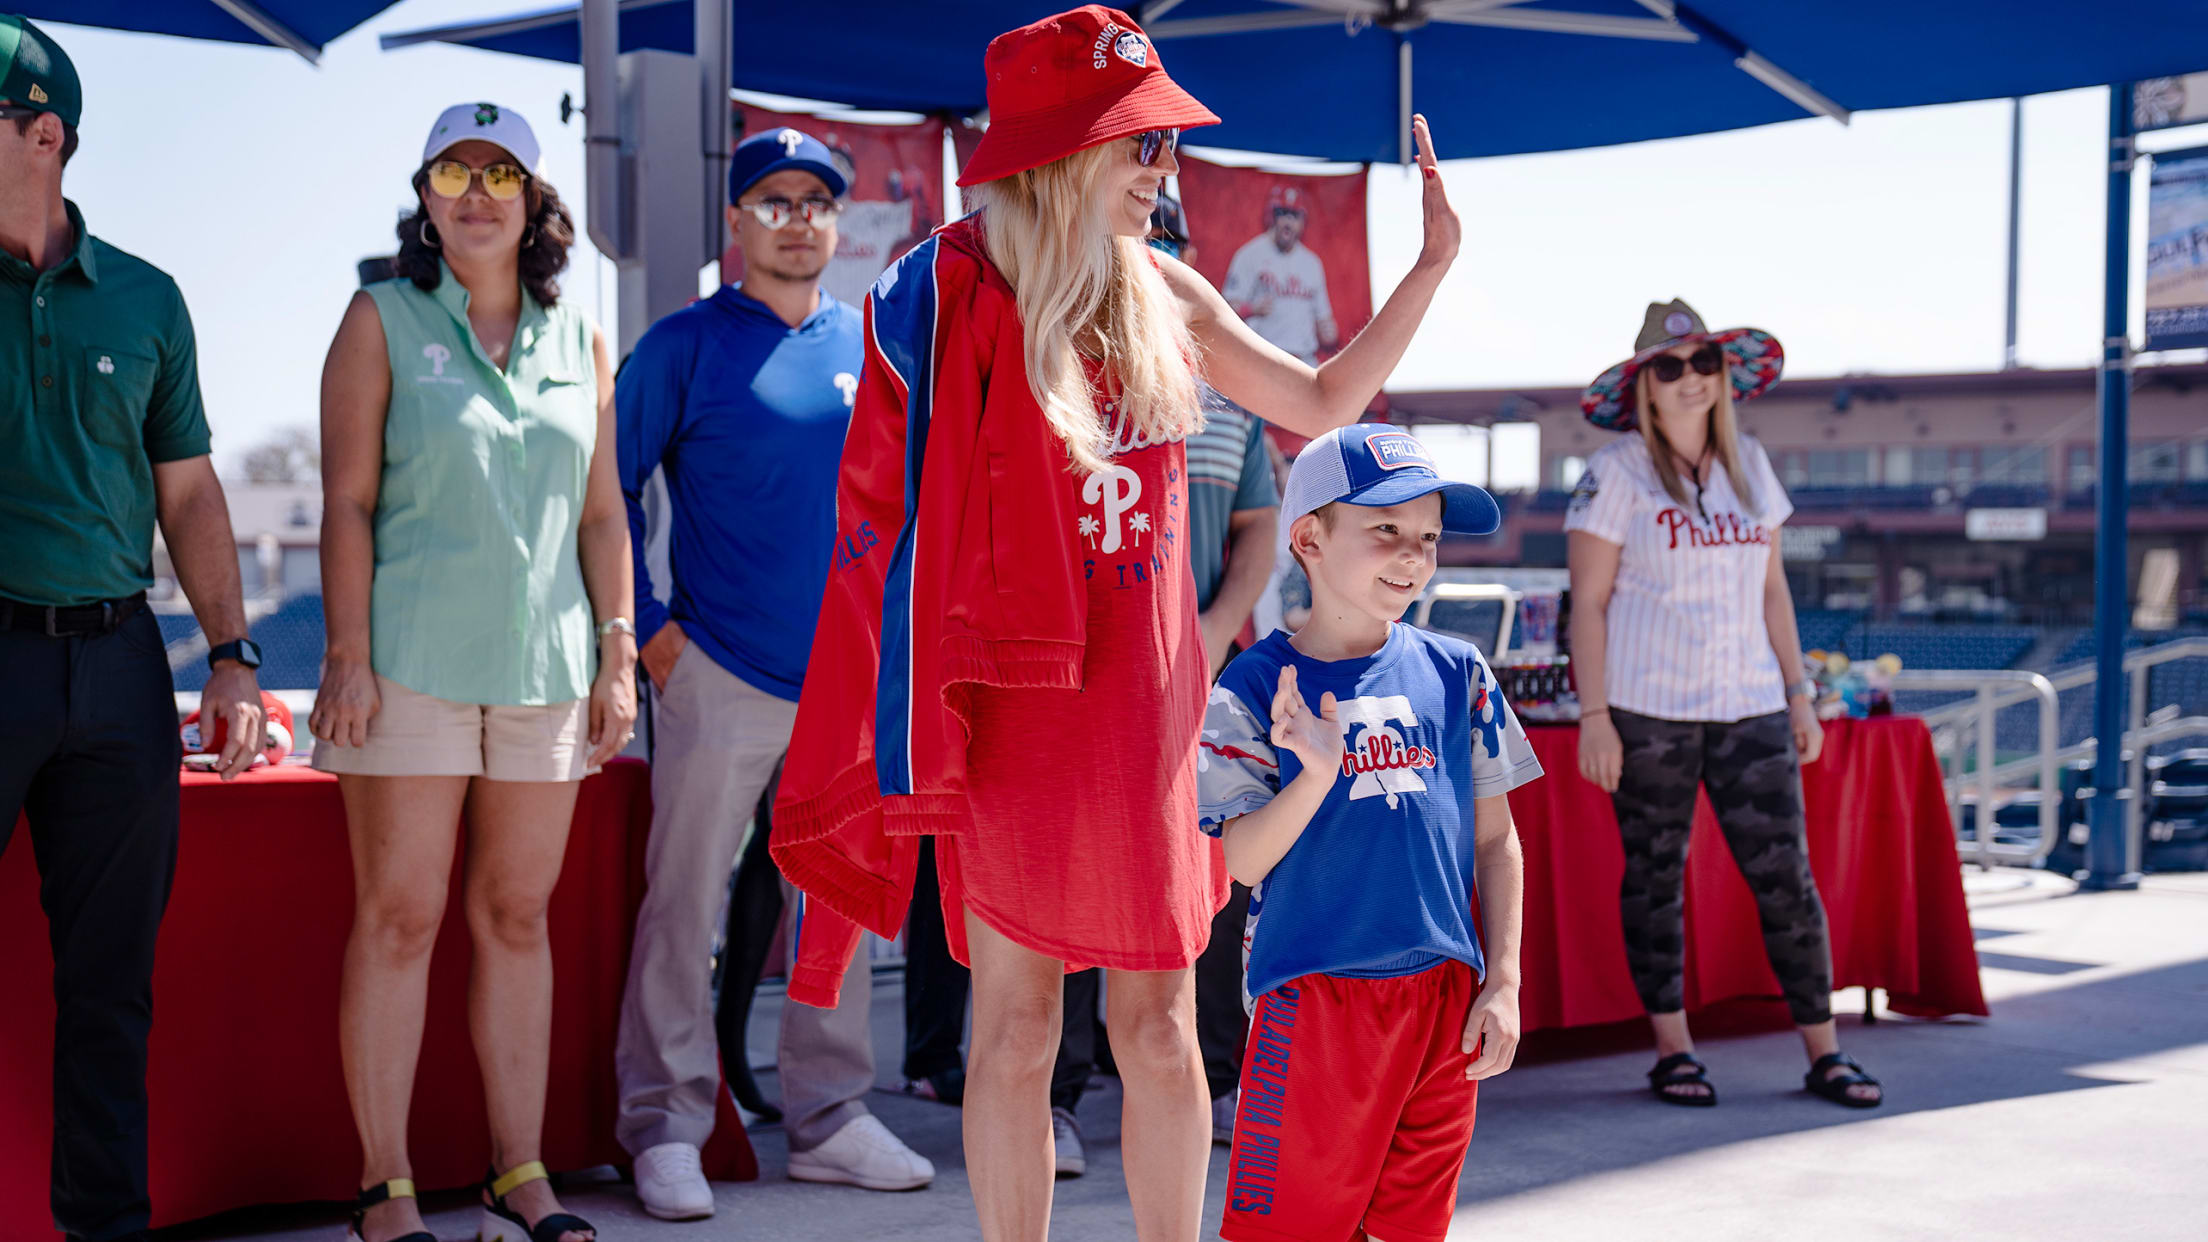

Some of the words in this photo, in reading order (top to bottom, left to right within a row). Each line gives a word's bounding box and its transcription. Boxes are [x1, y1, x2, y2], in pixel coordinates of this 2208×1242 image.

[1093, 23, 1119, 69] SPRING
[778, 129, 803, 157] P
[424, 344, 451, 375] P
[833, 373, 858, 406] P
[1116, 468, 1178, 585] TRAINING
[1656, 508, 1772, 549] Phillie
[1342, 733, 1436, 777] hillies
[1232, 1130, 1280, 1215] PHILLIES
